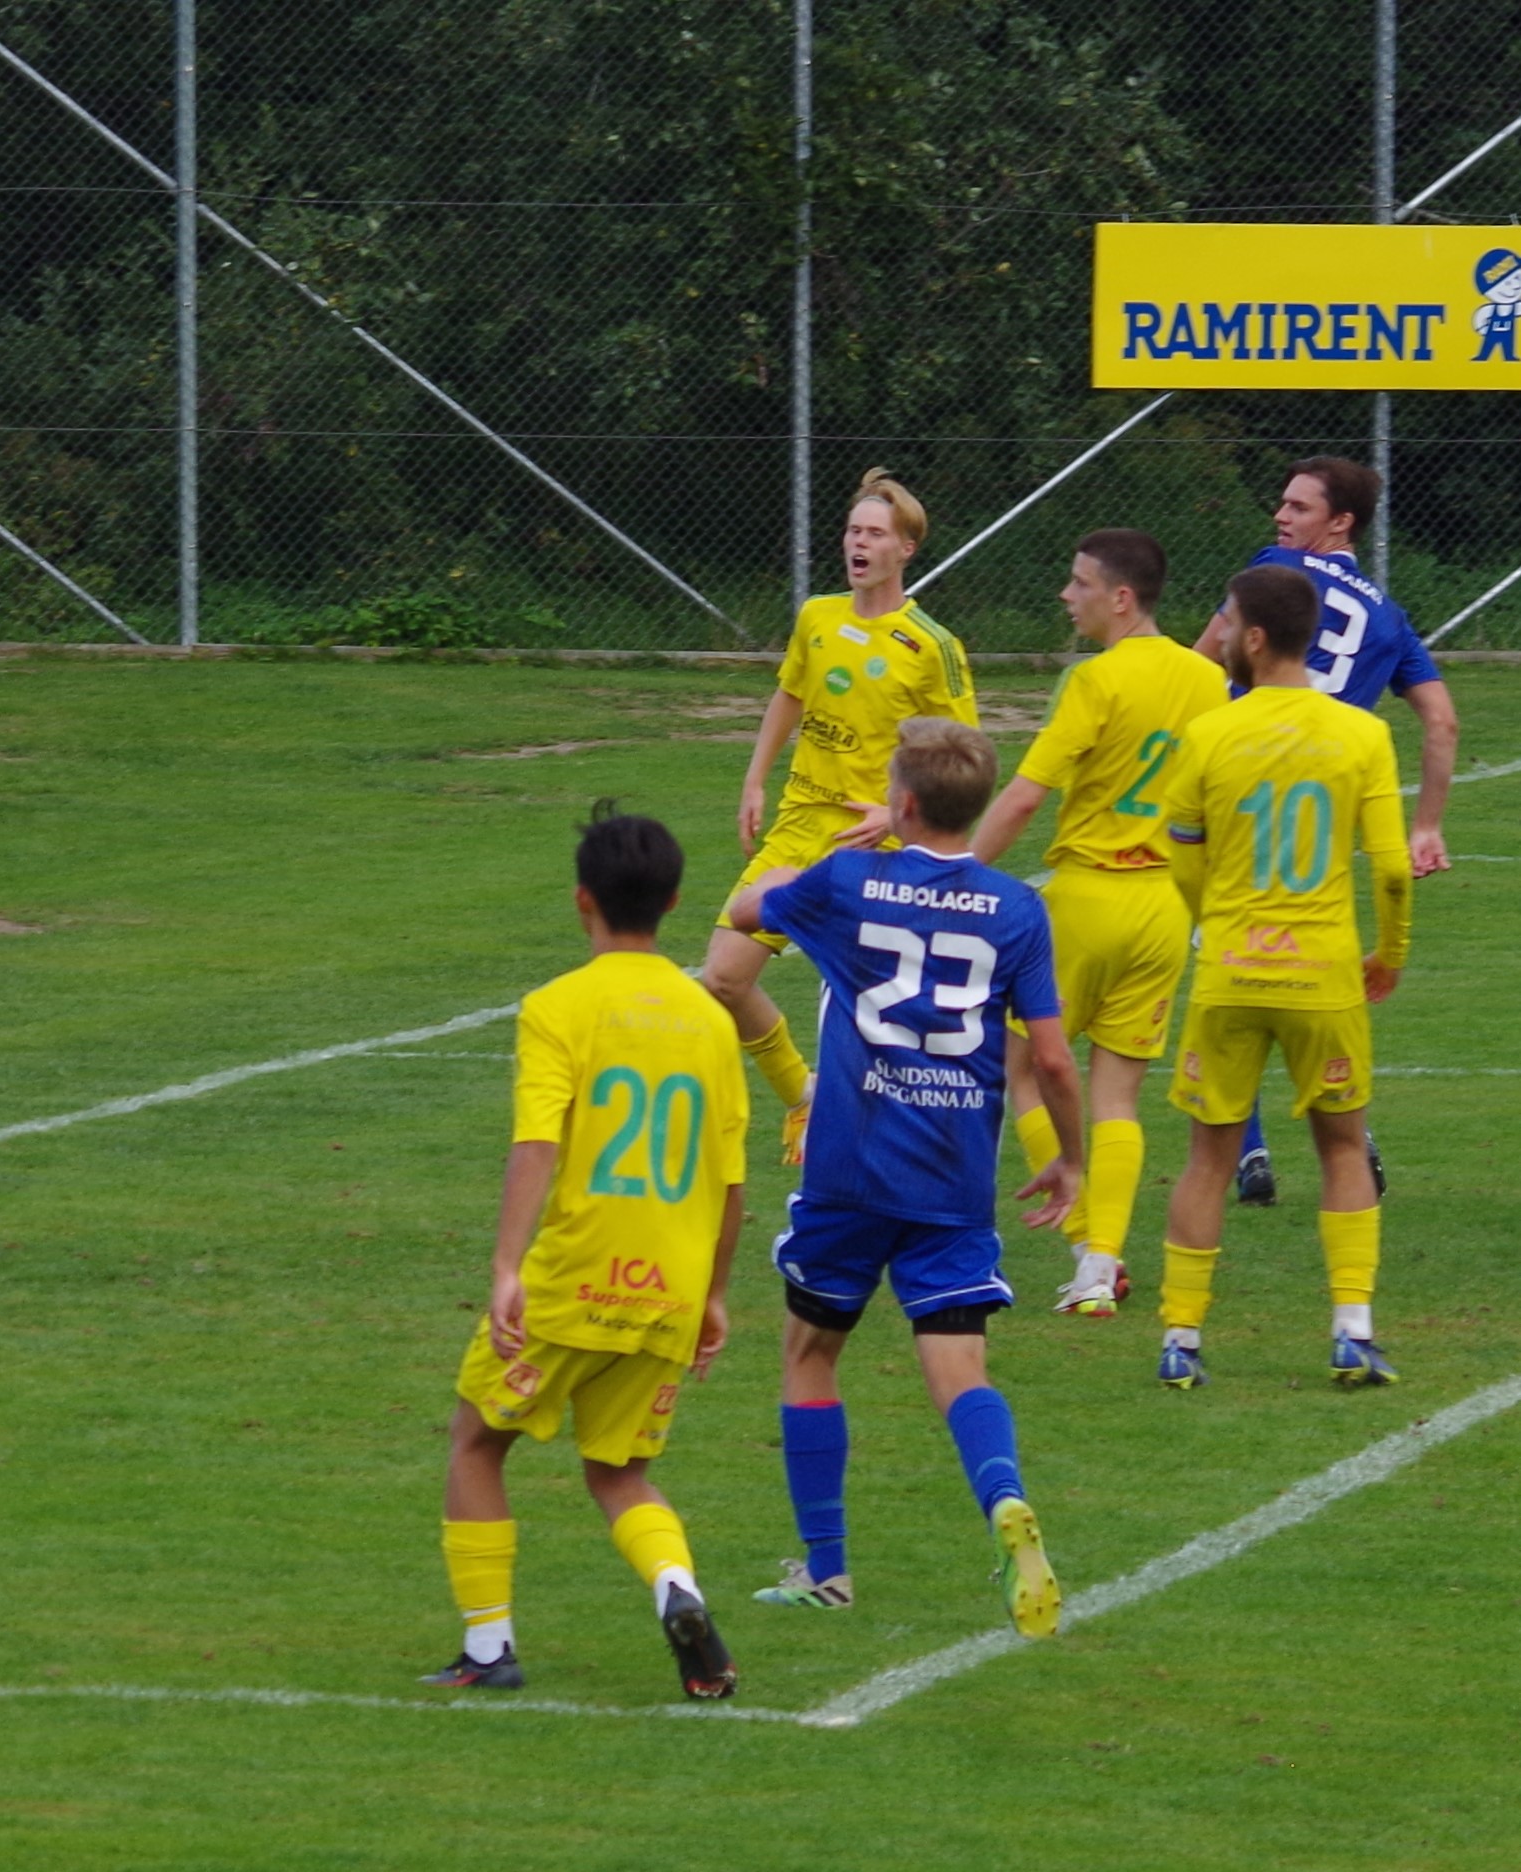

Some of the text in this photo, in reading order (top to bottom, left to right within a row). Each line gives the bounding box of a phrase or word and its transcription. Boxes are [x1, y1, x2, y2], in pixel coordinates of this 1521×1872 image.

[1122, 302, 1445, 361] RAMIRENT
[1237, 780, 1332, 893] 10
[863, 879, 1000, 915] BILBOLAGET
[1246, 925, 1300, 954] ICA
[856, 921, 997, 1055] 23
[863, 1070, 985, 1109] BYGGARNA AB
[875, 1058, 977, 1087] SUNDSVALLS
[588, 1066, 706, 1204] 20
[609, 1257, 667, 1293] ICA
